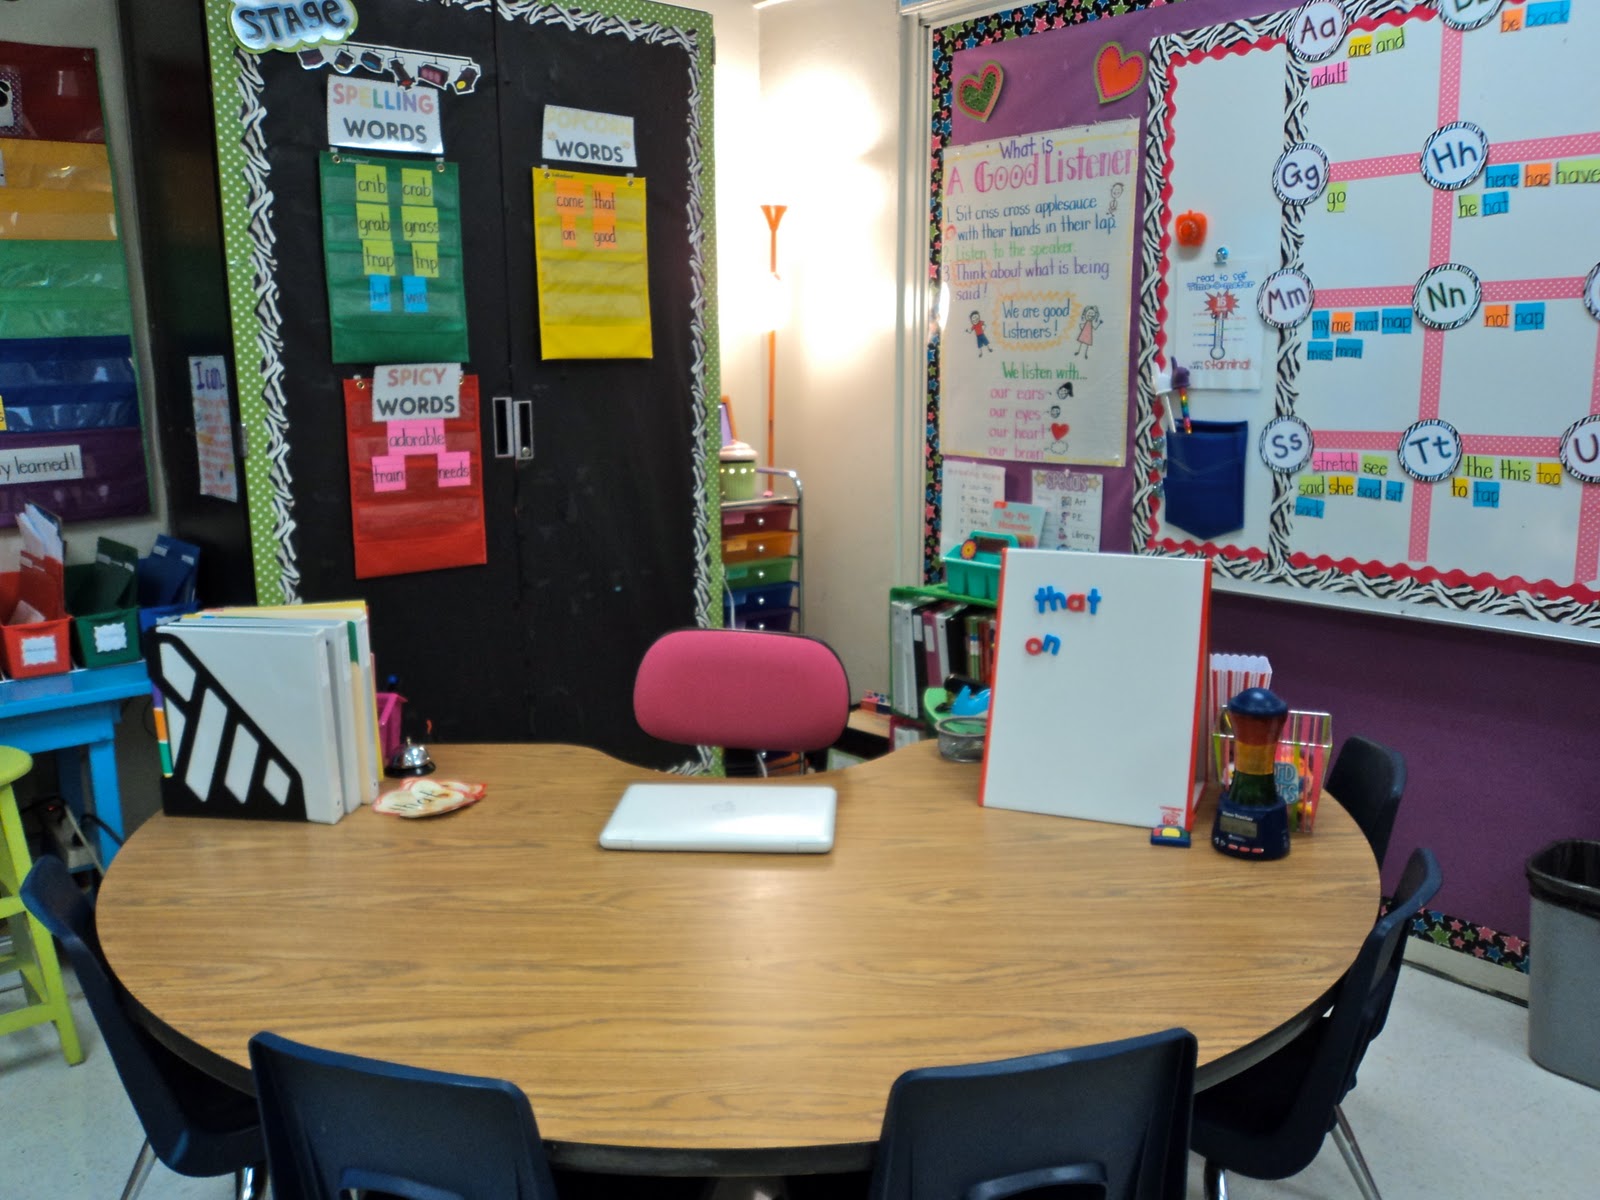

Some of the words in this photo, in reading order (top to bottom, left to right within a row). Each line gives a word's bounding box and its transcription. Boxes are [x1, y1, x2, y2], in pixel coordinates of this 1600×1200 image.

[1300, 15, 1337, 44] Aa
[1347, 42, 1372, 58] are
[1375, 27, 1405, 54] and
[1310, 61, 1347, 89] adult
[333, 83, 434, 115] SPELLING
[343, 117, 427, 144] WORDS
[556, 139, 624, 163] WORDS
[999, 136, 1036, 160] What
[1042, 136, 1054, 155] is
[1430, 141, 1478, 175] Hh
[946, 166, 965, 196] A
[974, 152, 1040, 193] Good
[1045, 146, 1138, 185] Listener
[1281, 162, 1321, 189] Gg
[1485, 165, 1519, 188] here
[1523, 163, 1551, 188] has
[1555, 161, 1600, 185] have
[358, 174, 386, 194] crib
[403, 177, 432, 197] crab
[556, 196, 584, 208] come
[594, 190, 616, 210] that
[956, 204, 973, 222] Sit
[975, 207, 1000, 220] criss
[1003, 204, 1031, 218] cross
[1035, 193, 1098, 219] applesauce
[1326, 191, 1347, 213] go
[1458, 194, 1477, 218] he
[360, 212, 390, 236] grab
[405, 221, 439, 238] grass
[562, 229, 576, 241] on
[594, 225, 616, 247] good
[957, 224, 979, 241] with
[982, 222, 1007, 240] their
[1010, 219, 1042, 238] hands
[1045, 222, 1057, 234] in
[1061, 214, 1092, 233] their
[363, 246, 395, 272] trap
[414, 250, 438, 274] trip
[993, 239, 1005, 258] to
[1009, 240, 1026, 257] the
[955, 261, 988, 281] Think
[991, 260, 1022, 280] about
[1025, 258, 1055, 278] what
[1058, 260, 1069, 275] is
[1074, 256, 1110, 281] being
[1266, 286, 1307, 315] Mm
[1426, 282, 1467, 312] Nn
[1002, 299, 1020, 319] We
[1022, 307, 1040, 319] are
[1043, 298, 1070, 324] good
[1484, 305, 1510, 328] not
[1515, 311, 1544, 330] nap
[1312, 319, 1329, 337] my
[1331, 320, 1352, 333] me
[1381, 316, 1411, 334] map
[387, 367, 447, 387] SPICY
[1001, 361, 1020, 379] We
[1022, 361, 1053, 380] listen
[376, 396, 455, 416] WORDS
[990, 387, 1011, 399] our
[1016, 389, 1045, 400] ears
[989, 407, 1008, 418] our
[1015, 409, 1041, 424] eyes
[389, 427, 446, 448] adorable
[988, 427, 1008, 438] our
[1013, 421, 1045, 440] heart
[988, 446, 1008, 457] our
[1013, 443, 1044, 460] brain
[1271, 433, 1303, 459] Ss
[1408, 435, 1452, 465] Tt
[14, 451, 77, 476] learned!
[374, 466, 404, 483] train
[438, 460, 470, 479] needs
[1313, 451, 1359, 473] stretch
[1363, 462, 1388, 477] see
[1463, 455, 1493, 479] the
[1499, 458, 1532, 482] this
[1536, 462, 1561, 486] too
[1298, 475, 1325, 496] said
[1328, 476, 1354, 496] she
[1357, 479, 1382, 500] sad
[1451, 477, 1468, 498] to
[1472, 482, 1500, 508] tap
[1034, 585, 1102, 615] that
[1025, 634, 1061, 656] on
